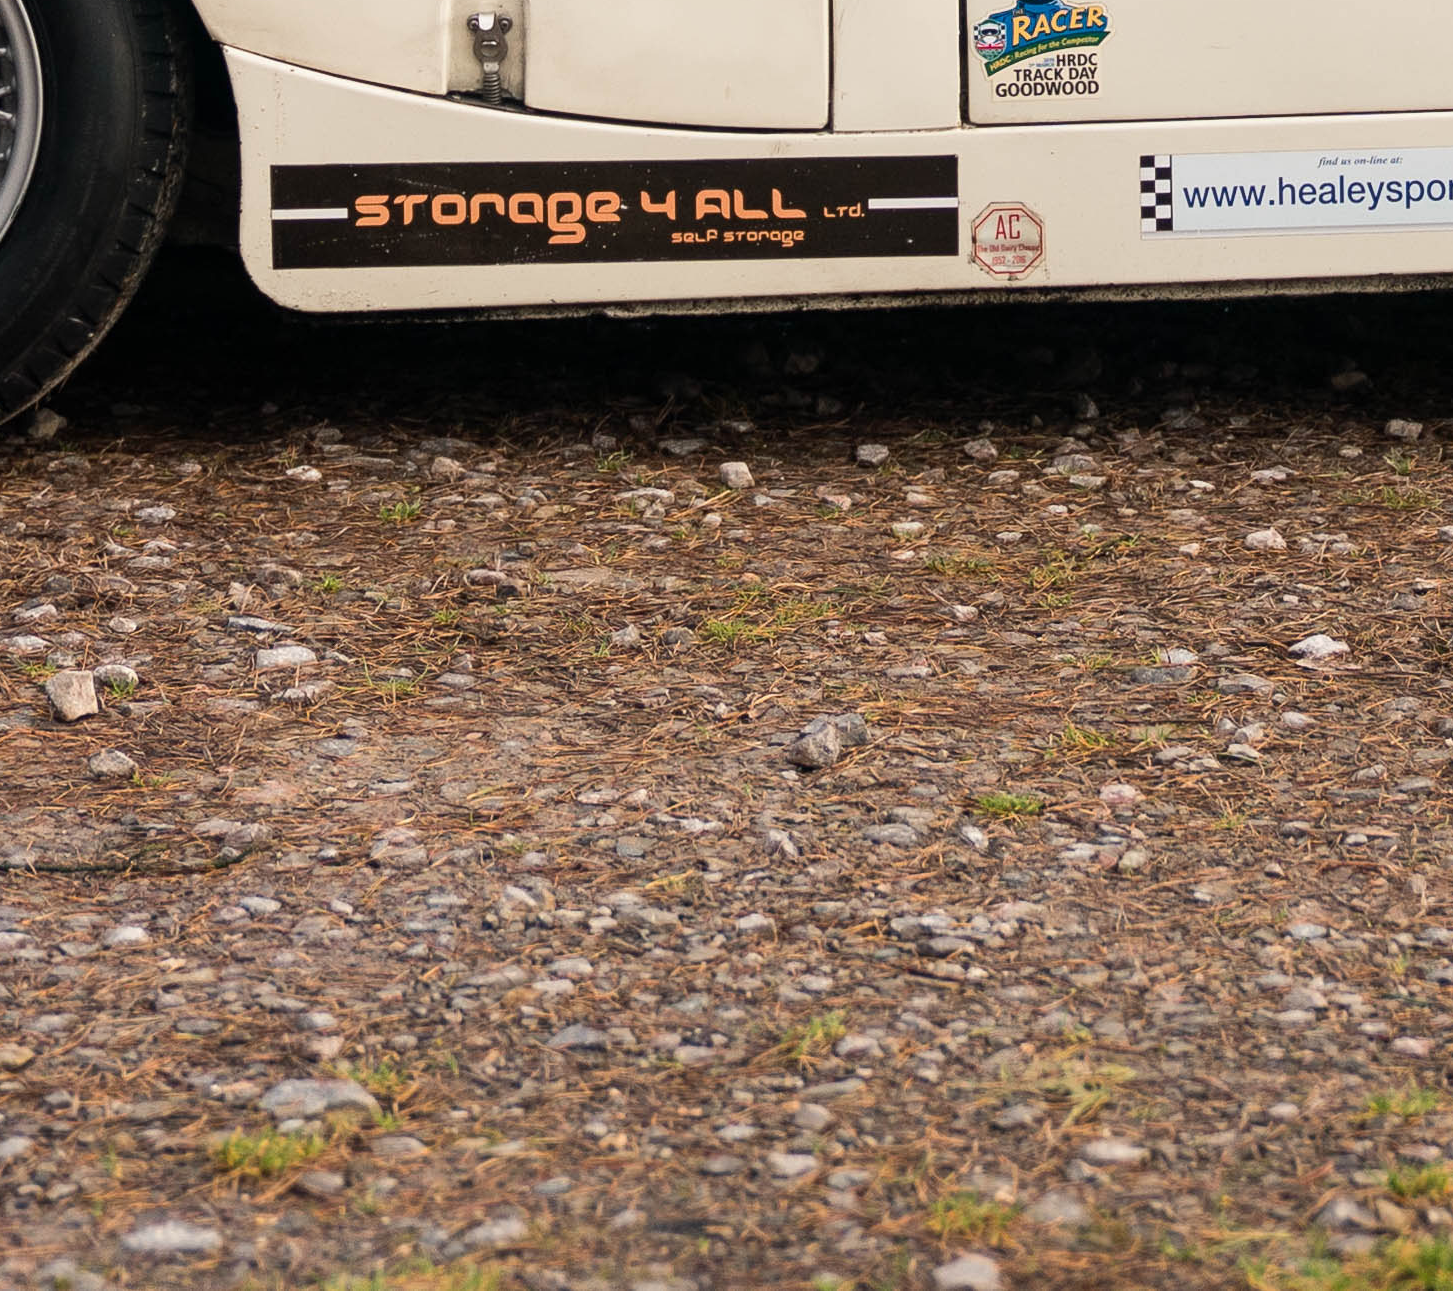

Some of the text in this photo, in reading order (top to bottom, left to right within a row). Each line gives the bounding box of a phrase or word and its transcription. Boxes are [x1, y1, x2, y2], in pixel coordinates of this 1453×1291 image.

[1013, 6, 1104, 46] RACER
[1038, 43, 1048, 53] for
[1056, 53, 1097, 67] HRDC
[1013, 66, 1098, 82] TRACK DAY
[995, 80, 1099, 98] GOODWOOD
[1317, 156, 1339, 169] find
[1354, 155, 1388, 165] on-line
[1389, 156, 1404, 165] at:
[640, 189, 676, 221] 4
[695, 188, 807, 220] ALL
[994, 213, 1021, 241] AC
